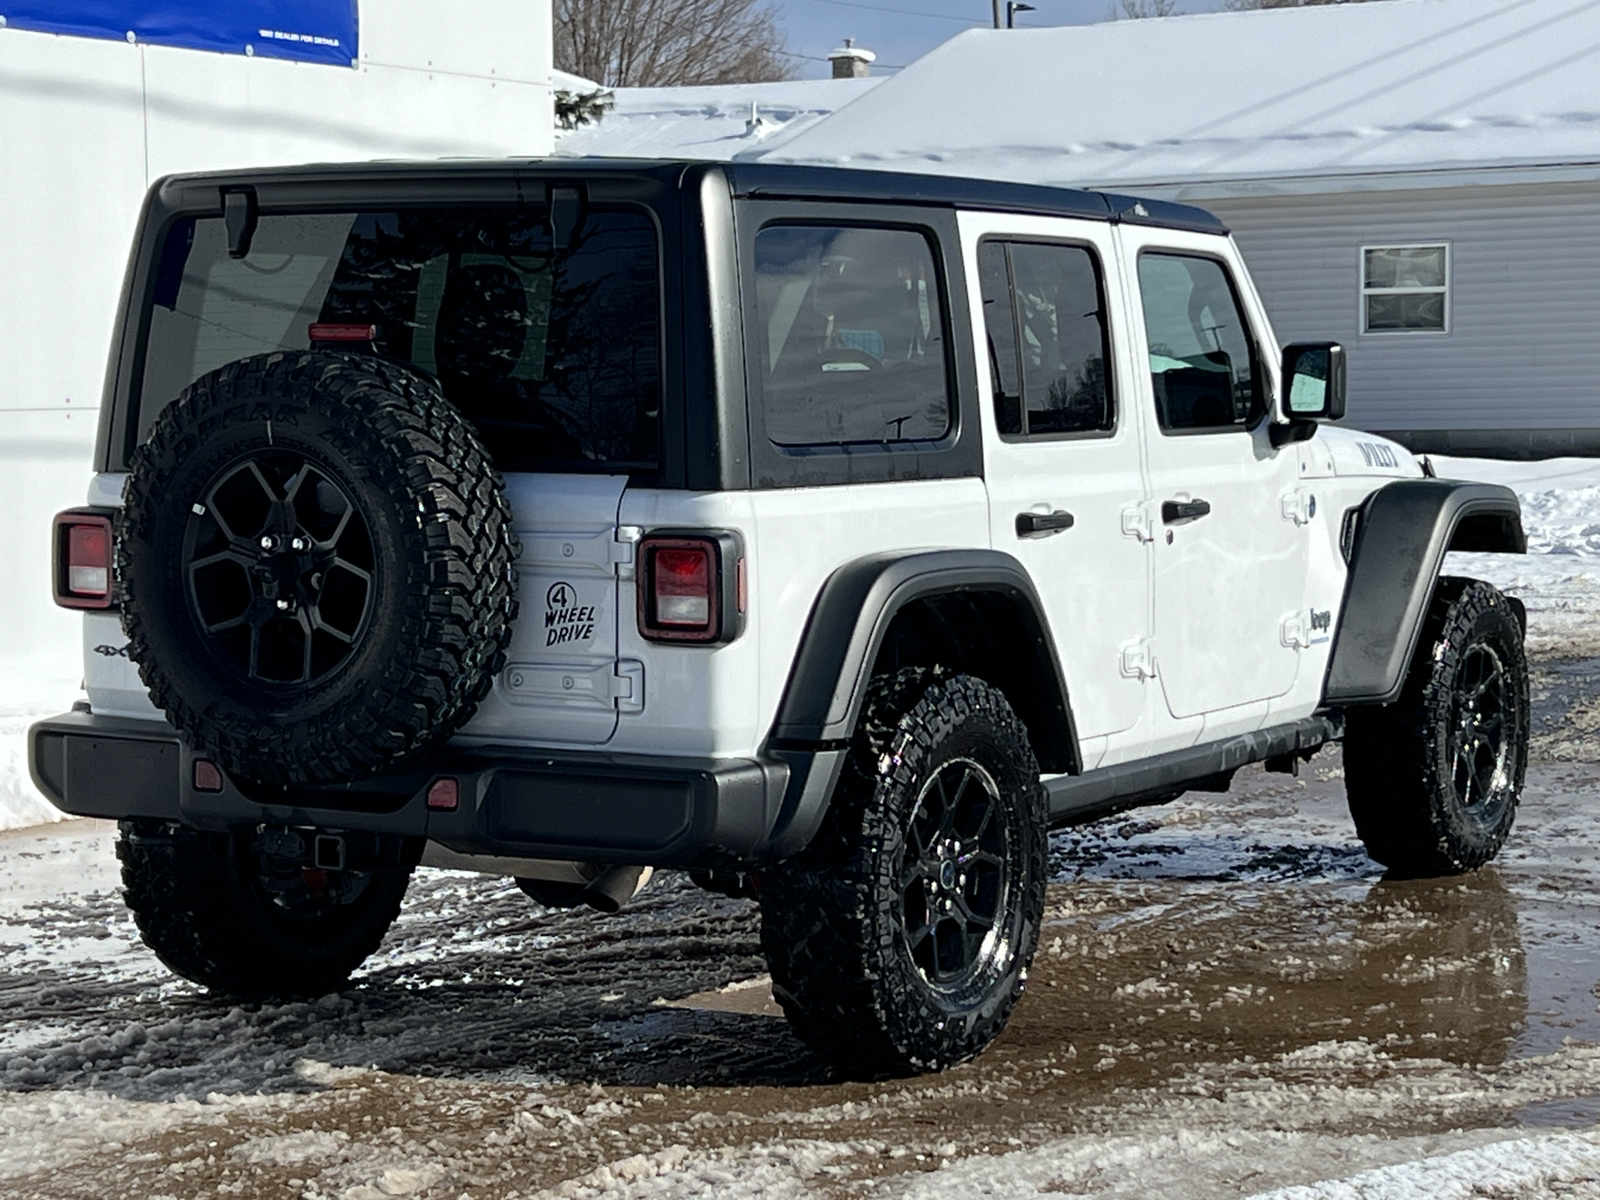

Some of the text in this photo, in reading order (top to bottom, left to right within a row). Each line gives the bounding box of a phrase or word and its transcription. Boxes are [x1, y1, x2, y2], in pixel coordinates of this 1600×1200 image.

[300, 34, 314, 43] FOR
[544, 606, 595, 628] WHEEL
[545, 624, 595, 647] DRIVE
